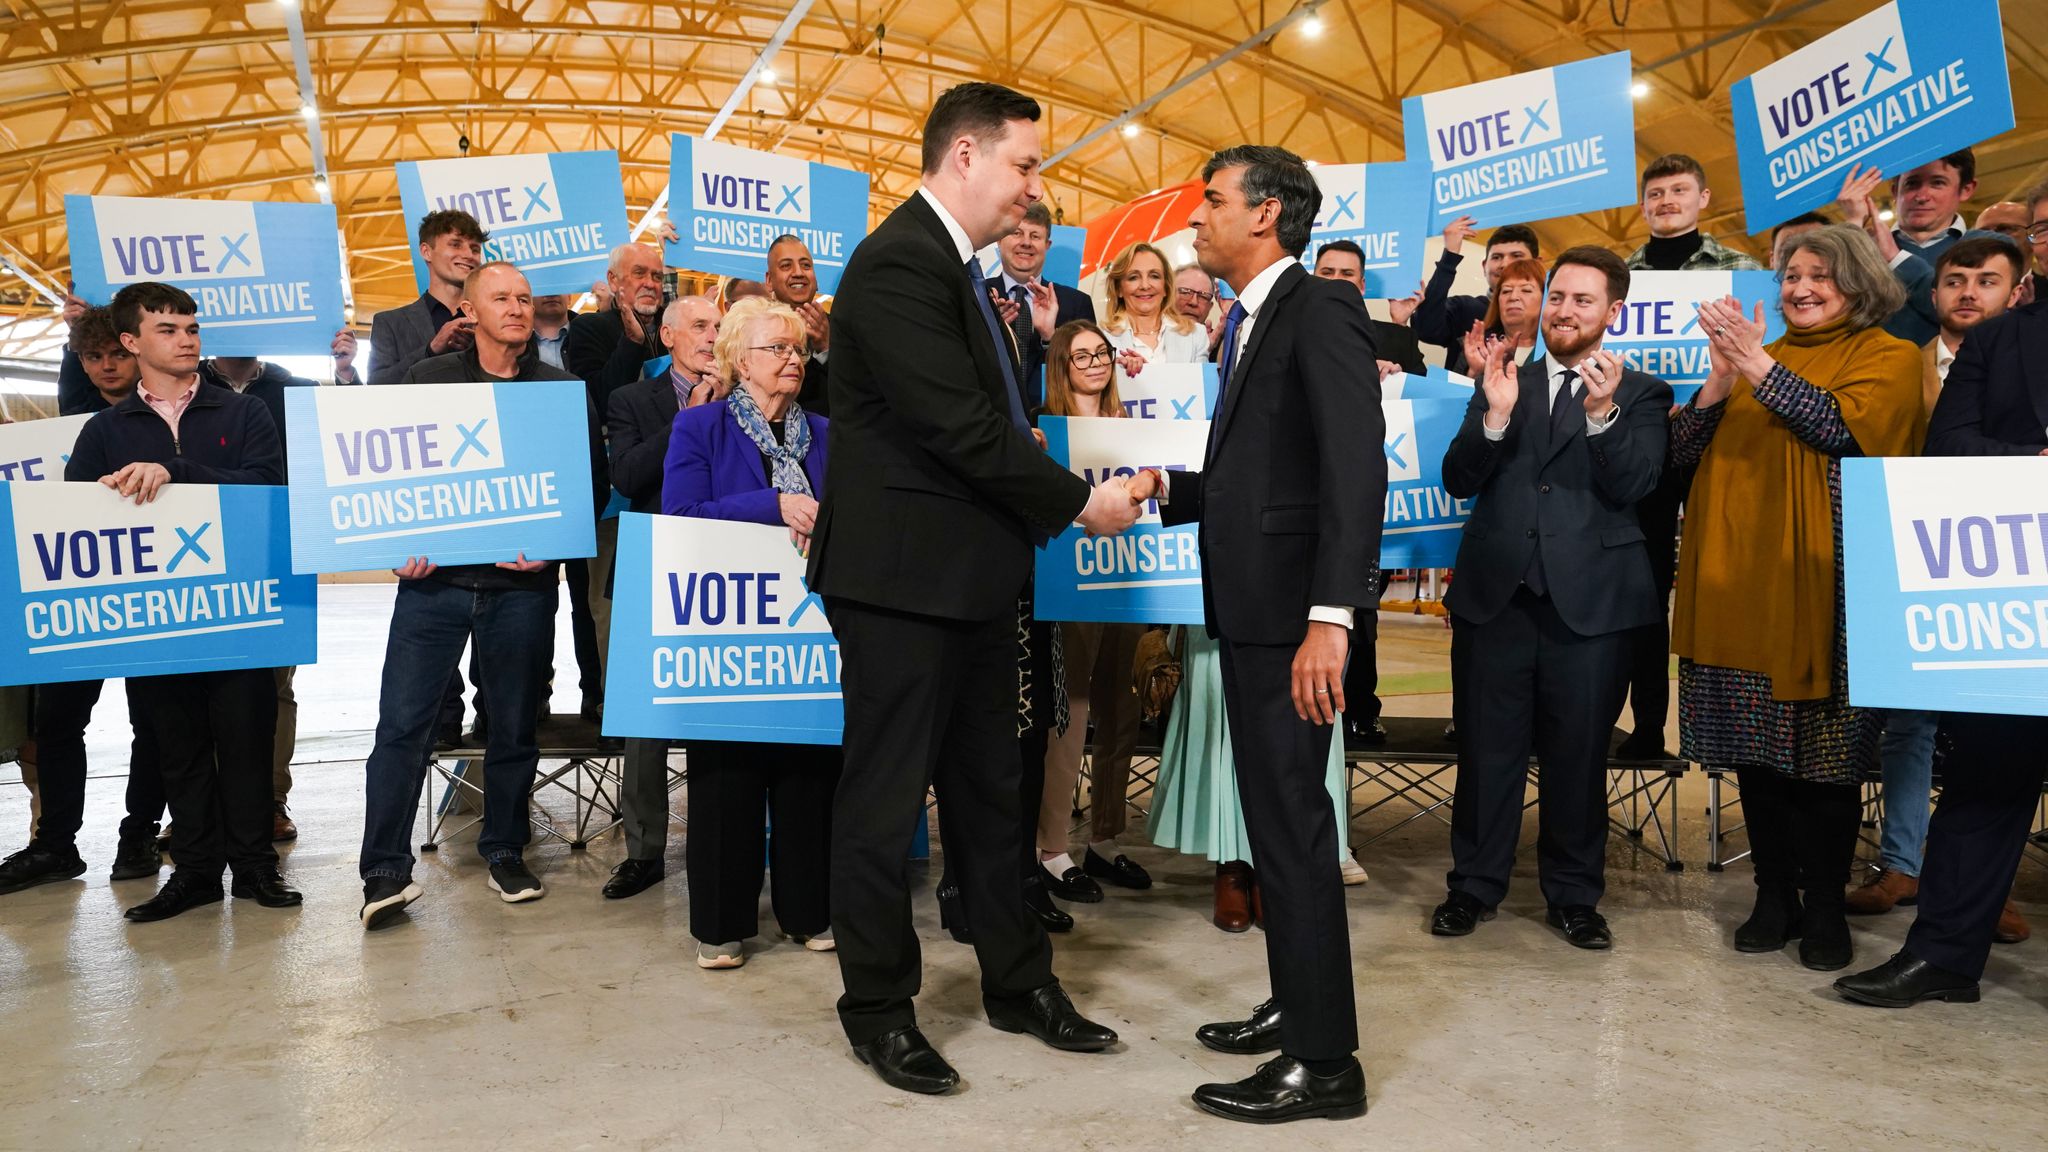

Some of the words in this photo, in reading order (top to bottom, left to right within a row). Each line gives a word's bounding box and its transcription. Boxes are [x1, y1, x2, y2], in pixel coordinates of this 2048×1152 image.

[1768, 62, 1856, 139] VOTE
[1769, 58, 1970, 189] CONSERVATIVE
[1436, 110, 1514, 162] VOTE
[702, 172, 770, 212] VOTE
[1434, 135, 1606, 205] CONSERVATIVE
[112, 234, 210, 276] VOTE
[335, 423, 443, 476] VOTE
[330, 471, 559, 530] CONSERVATIVE
[33, 526, 158, 582] VOTE
[1074, 532, 1198, 576] CONSER
[25, 578, 282, 640] CONSERVATIVE
[667, 571, 781, 626] VOTE
[652, 644, 842, 689] CONSERVAT
